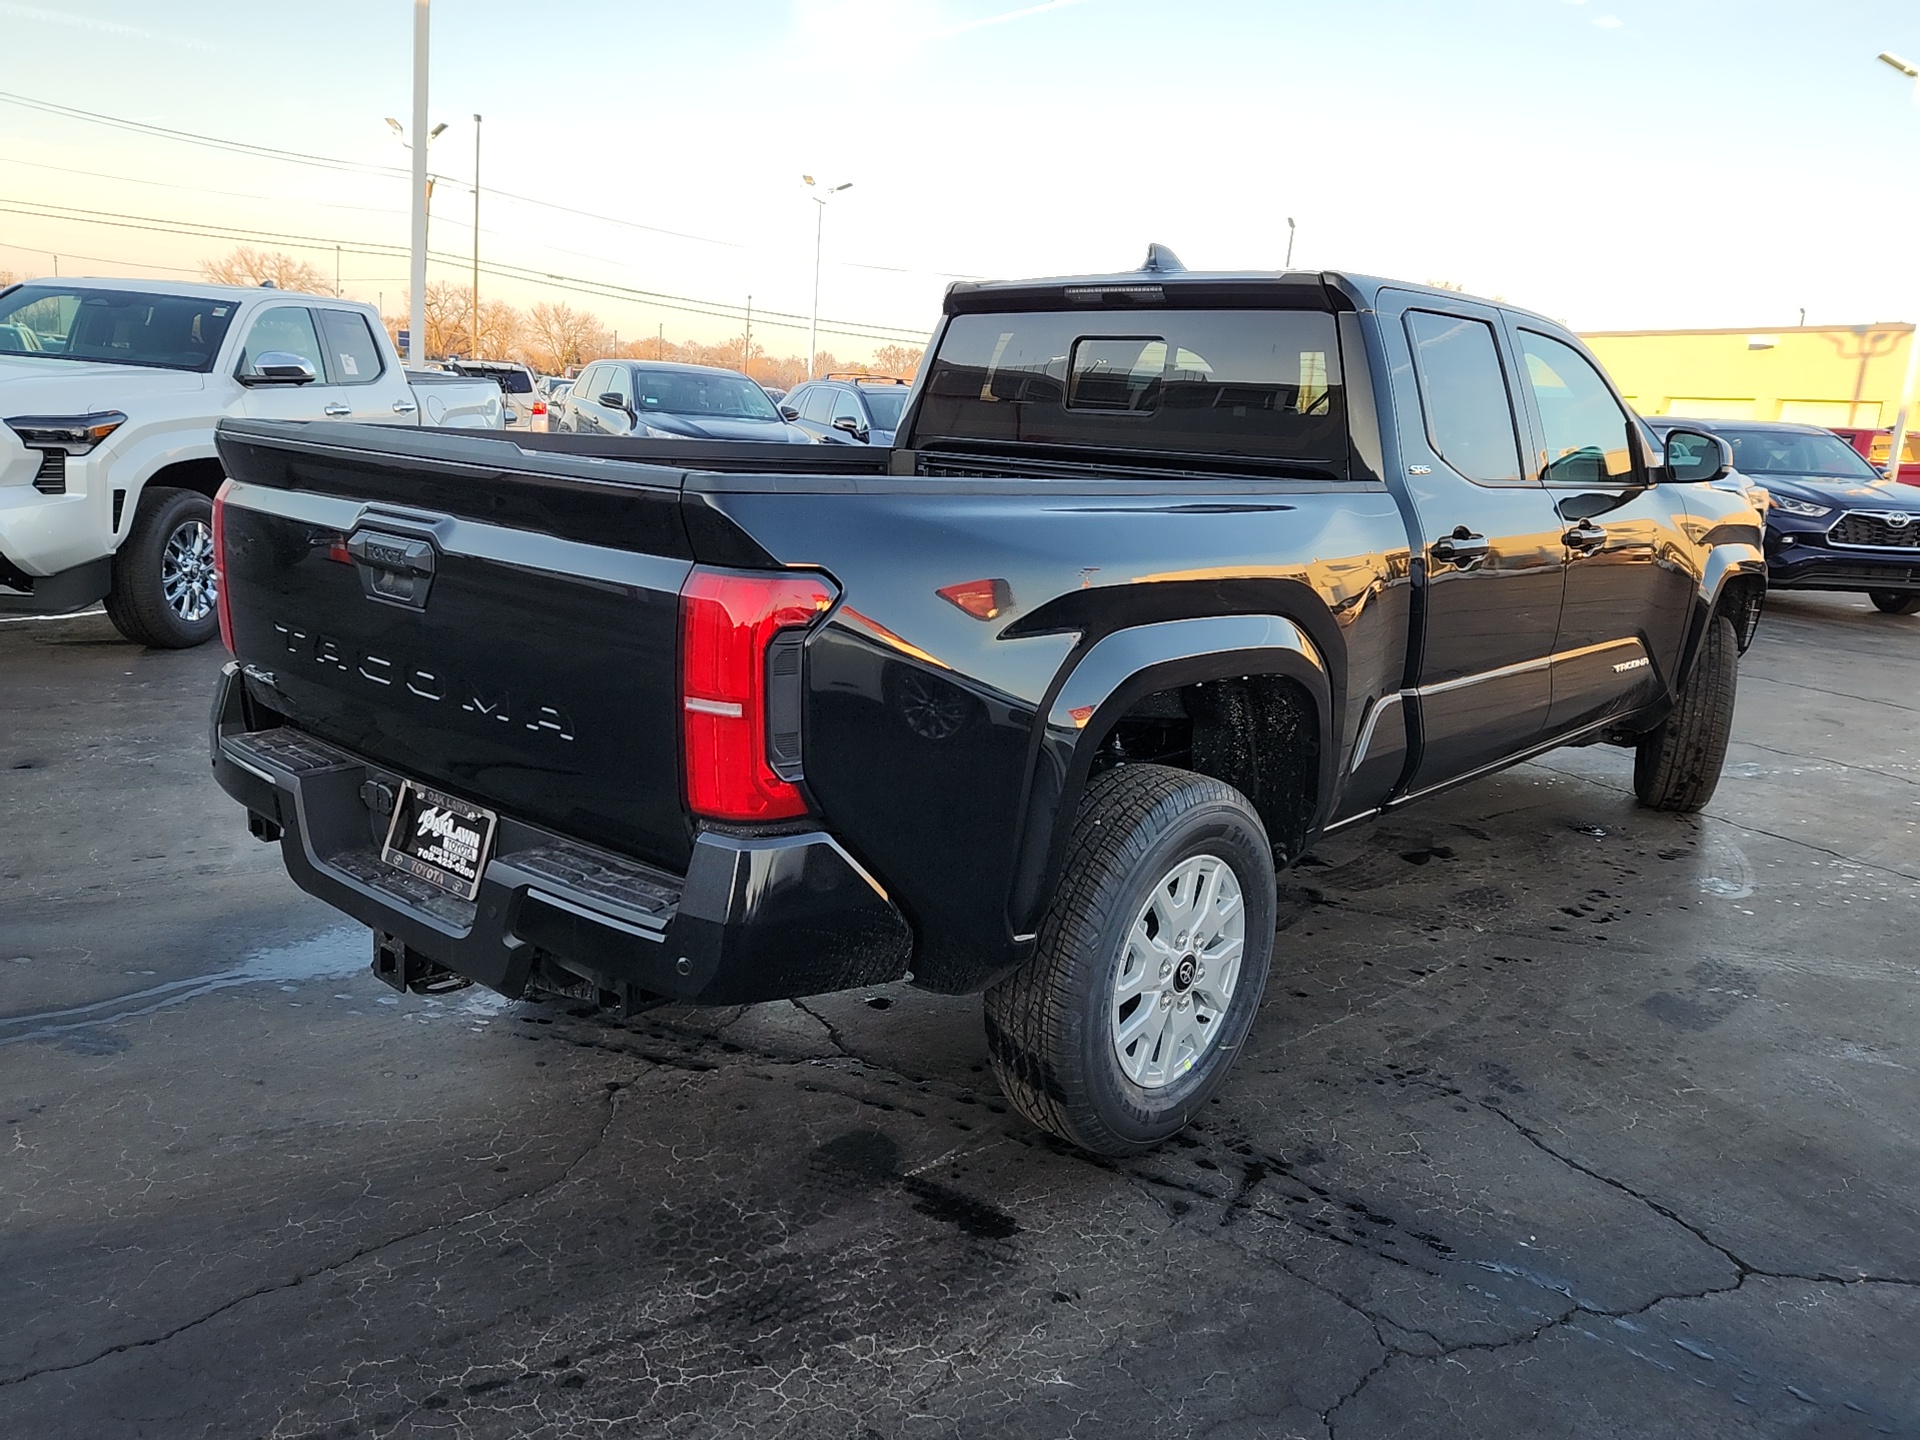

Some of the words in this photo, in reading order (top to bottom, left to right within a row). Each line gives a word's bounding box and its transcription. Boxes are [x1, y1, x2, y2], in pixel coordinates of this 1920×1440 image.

[1409, 464, 1432, 476] SR5
[1611, 657, 1650, 674] TACOMA
[272, 621, 575, 741] TACOMA
[427, 791, 446, 807] OAK
[446, 839, 475, 860] TOYOTA
[410, 861, 445, 885] TOYOTA
